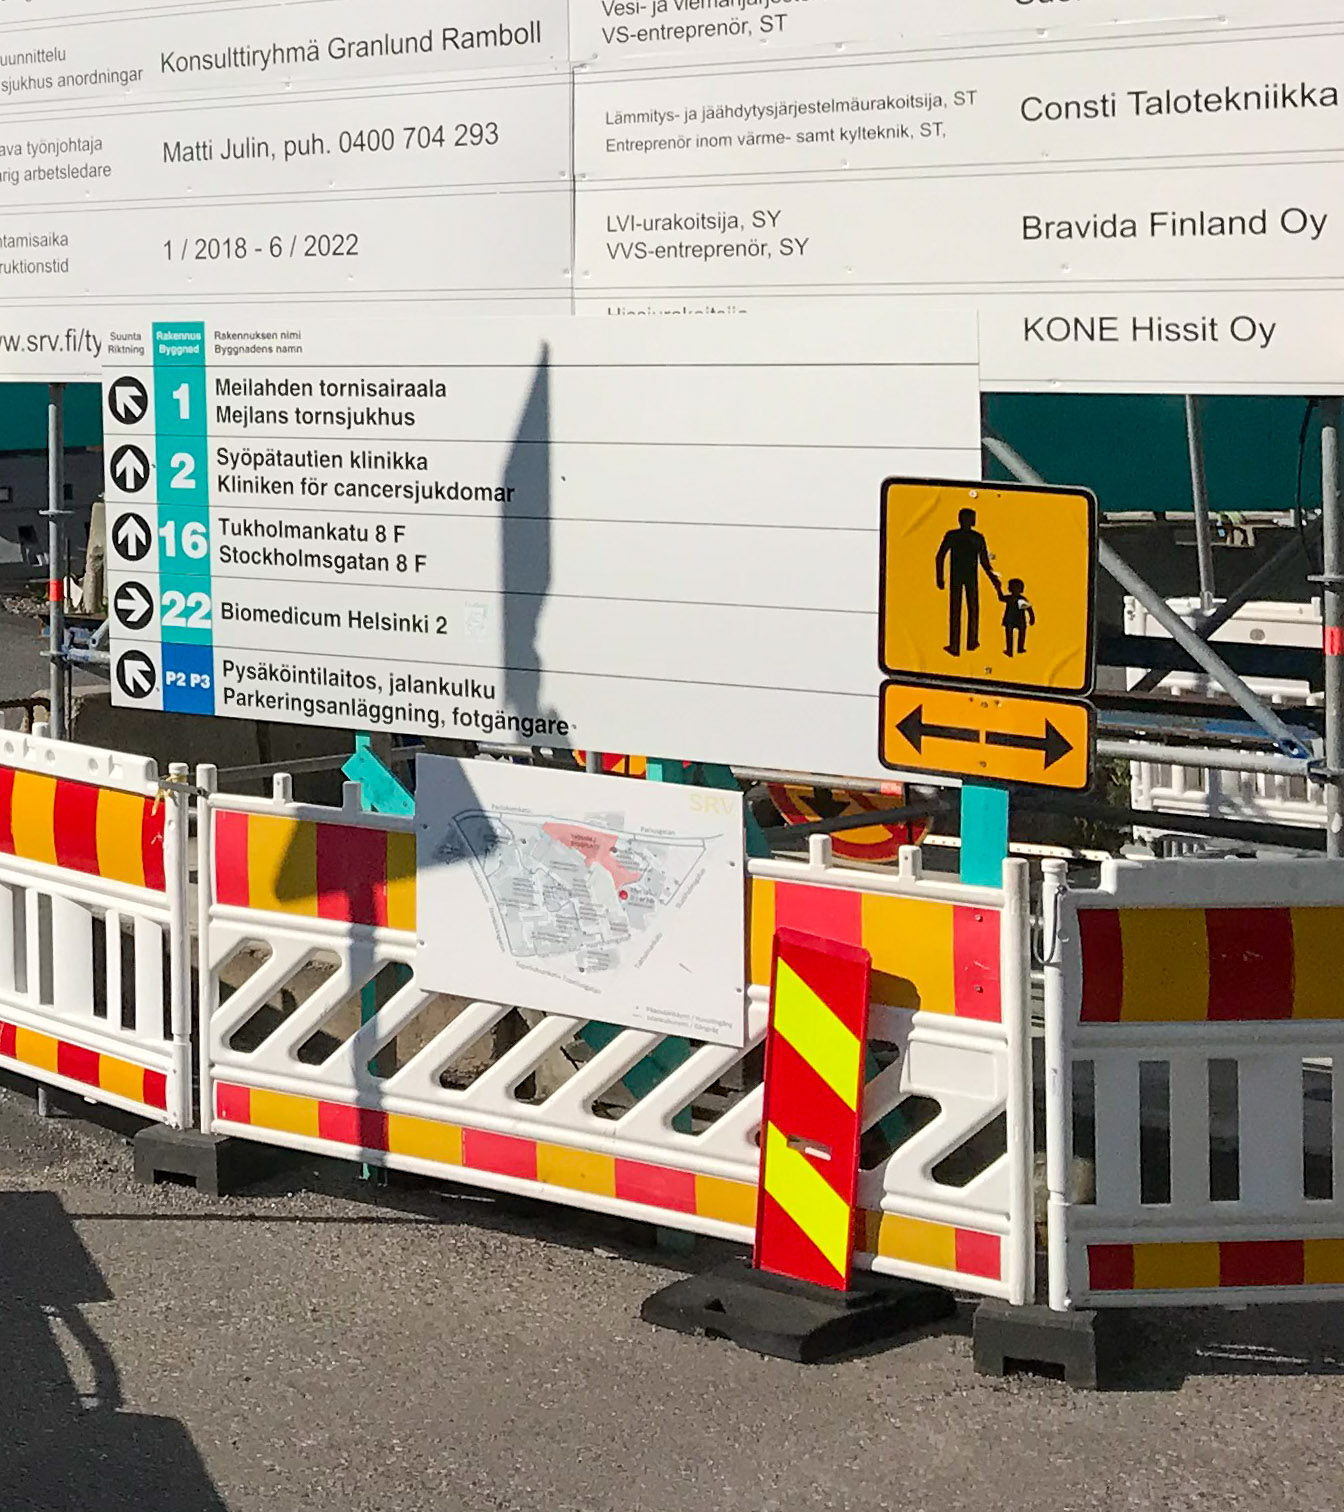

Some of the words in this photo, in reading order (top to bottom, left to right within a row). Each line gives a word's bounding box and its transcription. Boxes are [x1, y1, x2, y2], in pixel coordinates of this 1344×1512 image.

[602, 17, 752, 44] VS-entreprenör,
[760, 14, 787, 33] ST
[161, 41, 319, 73] Konsulttiryhmä
[328, 30, 432, 60] Granlund
[442, 21, 541, 51] Ramboll
[1, 75, 53, 94] sjukhus
[58, 68, 143, 89] anordningar
[605, 108, 680, 126] Lämmitys-
[684, 108, 697, 124] ja
[954, 91, 977, 106] ST
[1021, 93, 1116, 122] Consti
[1128, 83, 1338, 116] Talotekniikka
[27, 137, 103, 157] työnjohtaja
[163, 139, 213, 163] Matti
[221, 136, 275, 161] Julin,
[284, 132, 331, 161] puh.
[339, 128, 394, 153] 0400
[404, 125, 445, 150] 704
[455, 122, 499, 146] 293
[606, 134, 691, 154] Entreprenör
[696, 134, 732, 148] inom
[738, 131, 791, 146] värme-
[797, 128, 835, 143] samt
[840, 123, 914, 143] kylteknik,
[920, 122, 946, 138] ST,
[24, 164, 111, 182] arbetsledare
[606, 213, 744, 234] LVI-urakoitsija,
[752, 210, 781, 228] SY
[1022, 214, 1137, 240] Bravida
[1150, 209, 1267, 237] Finland
[1280, 208, 1327, 240] Oy
[164, 240, 172, 260] 1
[195, 237, 247, 260] 2018
[270, 236, 282, 258] 6
[304, 233, 359, 256] 2022
[607, 240, 772, 261] VVS-entreprenör,
[780, 238, 809, 255] SY
[110, 332, 141, 341] Suunta
[214, 331, 277, 340] Rakennuksen
[280, 331, 301, 339] nimi
[1024, 317, 1119, 342] KONE
[1132, 316, 1218, 342] Hissit
[1230, 316, 1276, 348] Oy
[215, 345, 273, 354] Byggnadens
[171, 383, 190, 420] 1
[215, 378, 313, 397] Meilahden
[319, 379, 447, 398] tornisairaala
[216, 406, 289, 427] Mejlans
[295, 407, 415, 428] tornsjukhus
[170, 453, 196, 488] 2
[217, 448, 343, 472] Syöpätautien
[350, 451, 428, 471] klinikka
[217, 475, 294, 495] Kliniken
[300, 477, 328, 496] för
[334, 480, 514, 504] cancersjukdomar
[160, 522, 207, 559] 16
[218, 518, 369, 542] Tukholmankatu
[375, 525, 388, 543] 8
[394, 525, 406, 543] F
[220, 545, 388, 573] Stockholmsgatan
[395, 554, 409, 572] 8
[415, 555, 427, 573] F
[161, 592, 211, 628] 22
[221, 603, 341, 628] Biomedicum
[348, 610, 429, 634] Helsinki
[435, 616, 448, 634] 2
[166, 672, 186, 687] P2
[190, 673, 210, 689] P3
[223, 660, 383, 693] Pysäköintilaitos,
[389, 673, 496, 700] jalankulku
[223, 689, 445, 729] Parkeringsanläggning,
[452, 705, 569, 737] fotgängare
[690, 794, 735, 815] SRV
